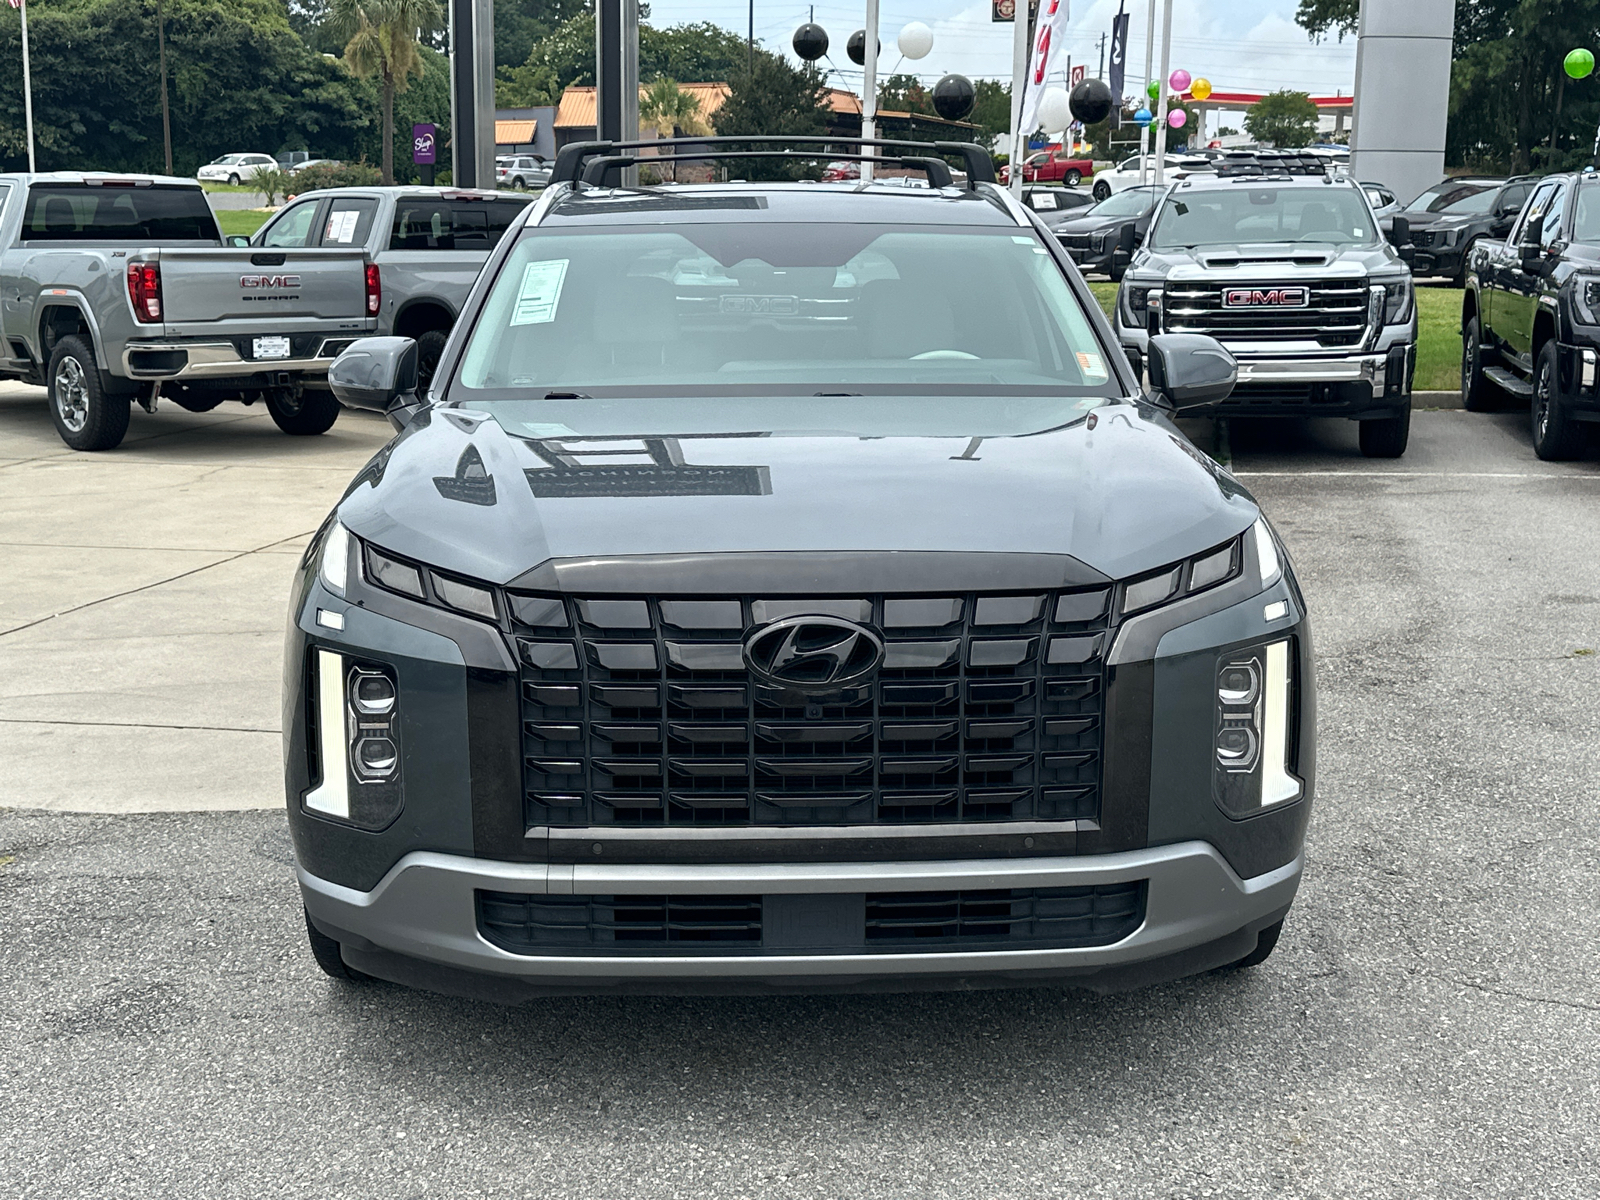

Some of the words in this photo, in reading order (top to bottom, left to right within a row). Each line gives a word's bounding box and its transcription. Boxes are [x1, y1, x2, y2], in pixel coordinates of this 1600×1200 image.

[240, 275, 301, 289] GMC
[725, 297, 792, 312] GMC
[1228, 290, 1303, 305] GMC
